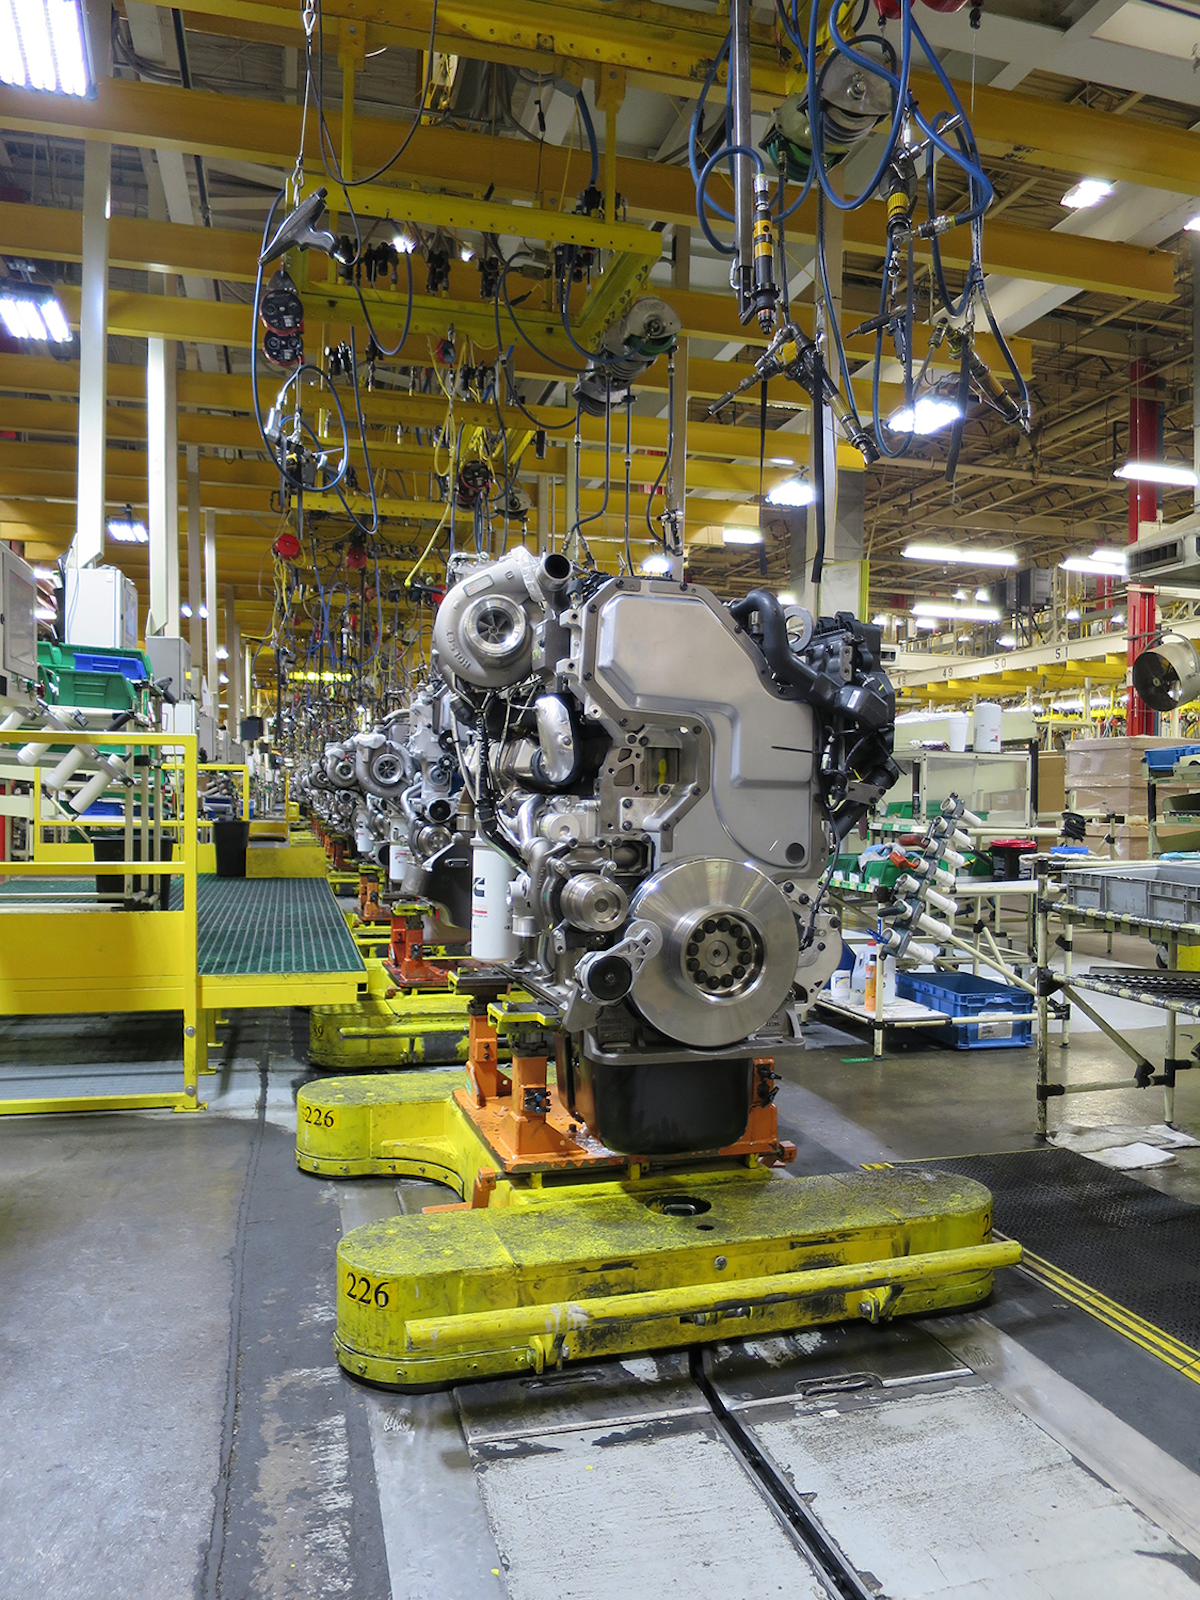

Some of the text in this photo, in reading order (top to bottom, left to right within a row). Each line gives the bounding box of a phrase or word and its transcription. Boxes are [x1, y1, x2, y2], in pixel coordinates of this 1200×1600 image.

[1055, 646, 1068, 660] 51
[993, 657, 1007, 669] 50
[942, 667, 954, 678] 49
[897, 675, 907, 685] 48
[304, 1105, 335, 1128] 226
[346, 1271, 390, 1308] 226
